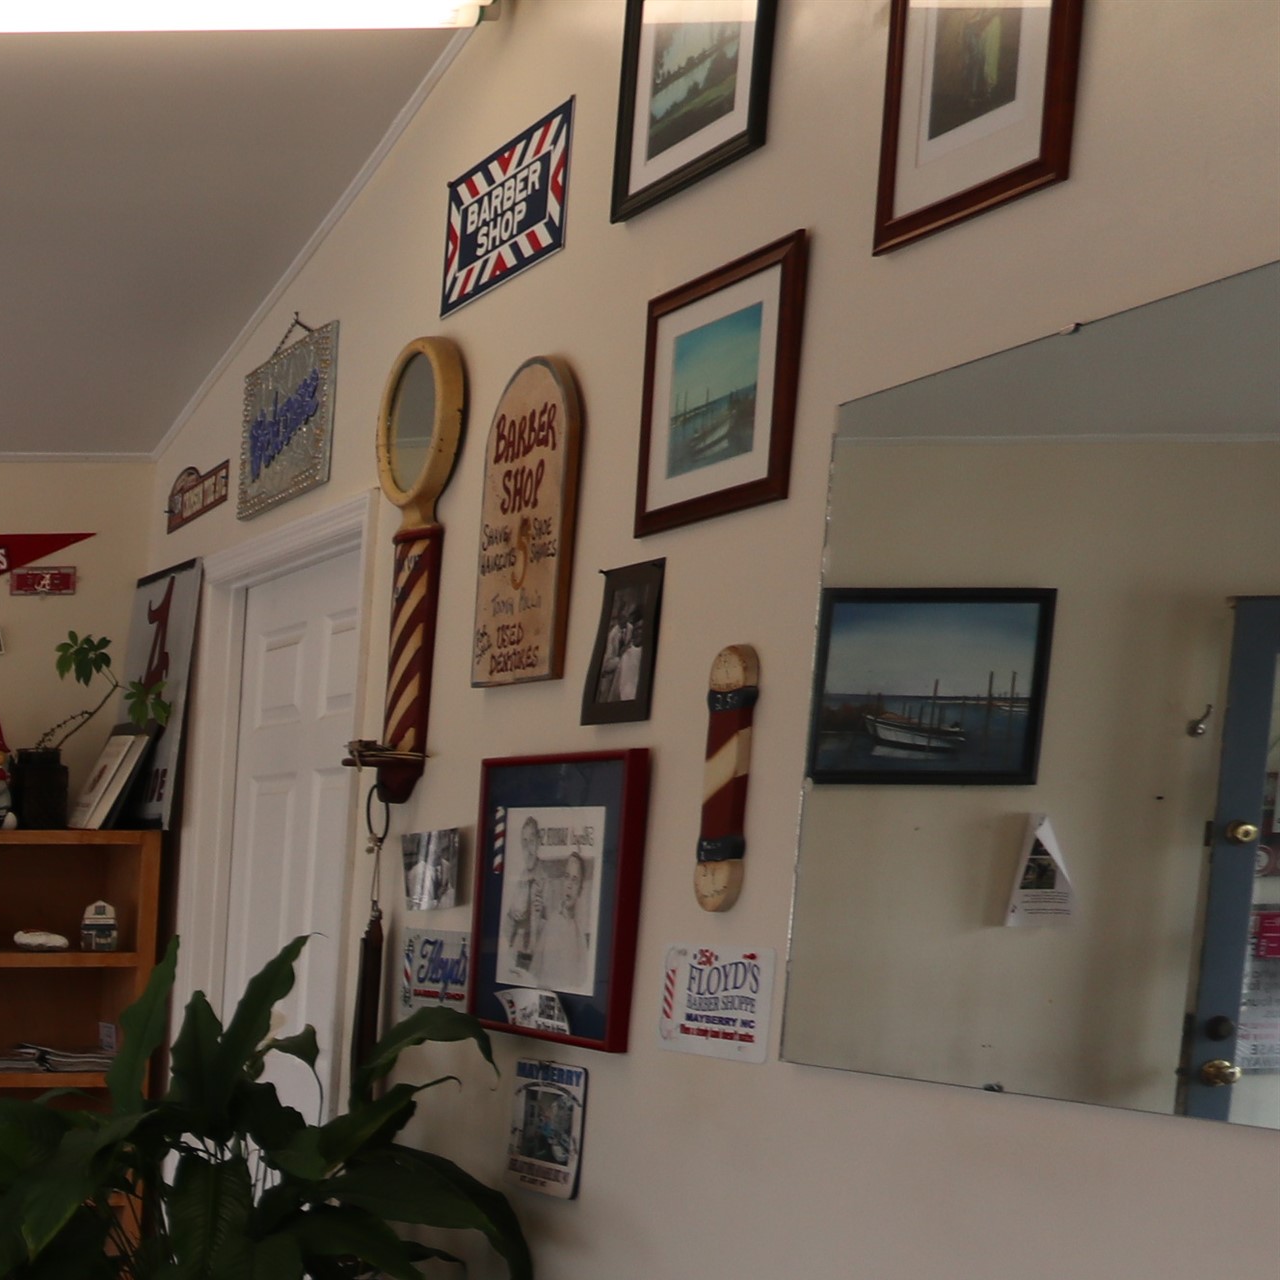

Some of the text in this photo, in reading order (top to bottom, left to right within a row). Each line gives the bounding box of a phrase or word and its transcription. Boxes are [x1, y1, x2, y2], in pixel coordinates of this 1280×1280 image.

[466, 160, 542, 235] BARBER
[475, 201, 527, 257] SHOP
[493, 402, 557, 465] BARBER
[500, 458, 546, 516] SHOP
[496, 622, 524, 650] USED
[686, 961, 761, 996] FLOYD'S
[685, 1012, 756, 1029] MAYBERRY NC
